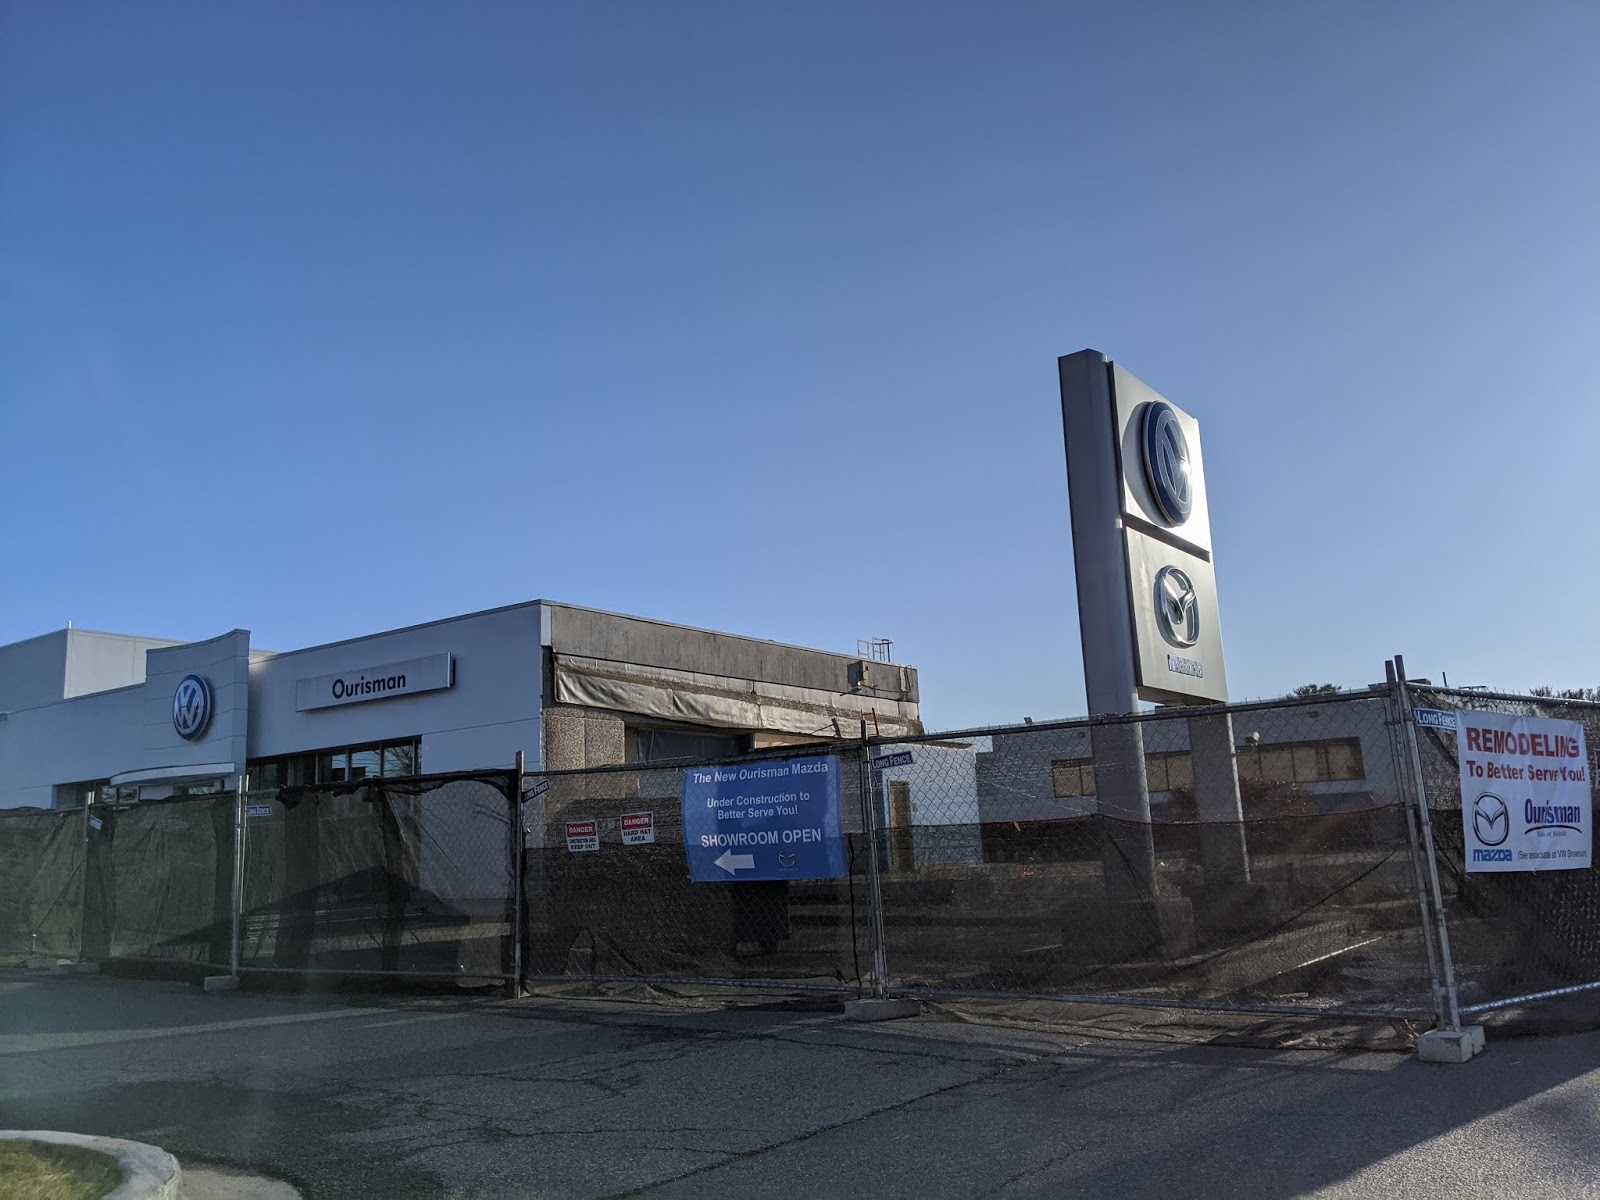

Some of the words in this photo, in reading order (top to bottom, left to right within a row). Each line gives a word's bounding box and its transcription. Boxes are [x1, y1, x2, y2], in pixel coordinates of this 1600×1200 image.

[332, 674, 406, 699] Ourisman
[1417, 710, 1439, 724] LONG
[1466, 727, 1580, 758] REMODELING
[871, 757, 890, 769] LONG
[889, 754, 911, 766] FENCE
[693, 773, 712, 784] The
[714, 771, 738, 782] New
[739, 767, 789, 780] Ourisman
[791, 762, 829, 774] Mazda
[1466, 760, 1484, 778] To
[1487, 761, 1524, 780] Better
[1528, 764, 1558, 782] Serve
[1559, 766, 1585, 782] You!
[707, 798, 734, 808] Under
[736, 793, 797, 806] Construction
[799, 792, 810, 801] to
[717, 809, 745, 820] Better
[747, 808, 774, 818] Serve
[776, 804, 799, 816] You!
[1524, 798, 1581, 824] Ourisman
[623, 817, 649, 826] DANGER
[568, 826, 594, 834] DANGER
[701, 831, 779, 848] SHOWROOM
[782, 828, 822, 844] OPEN
[1472, 849, 1512, 862] mazda
